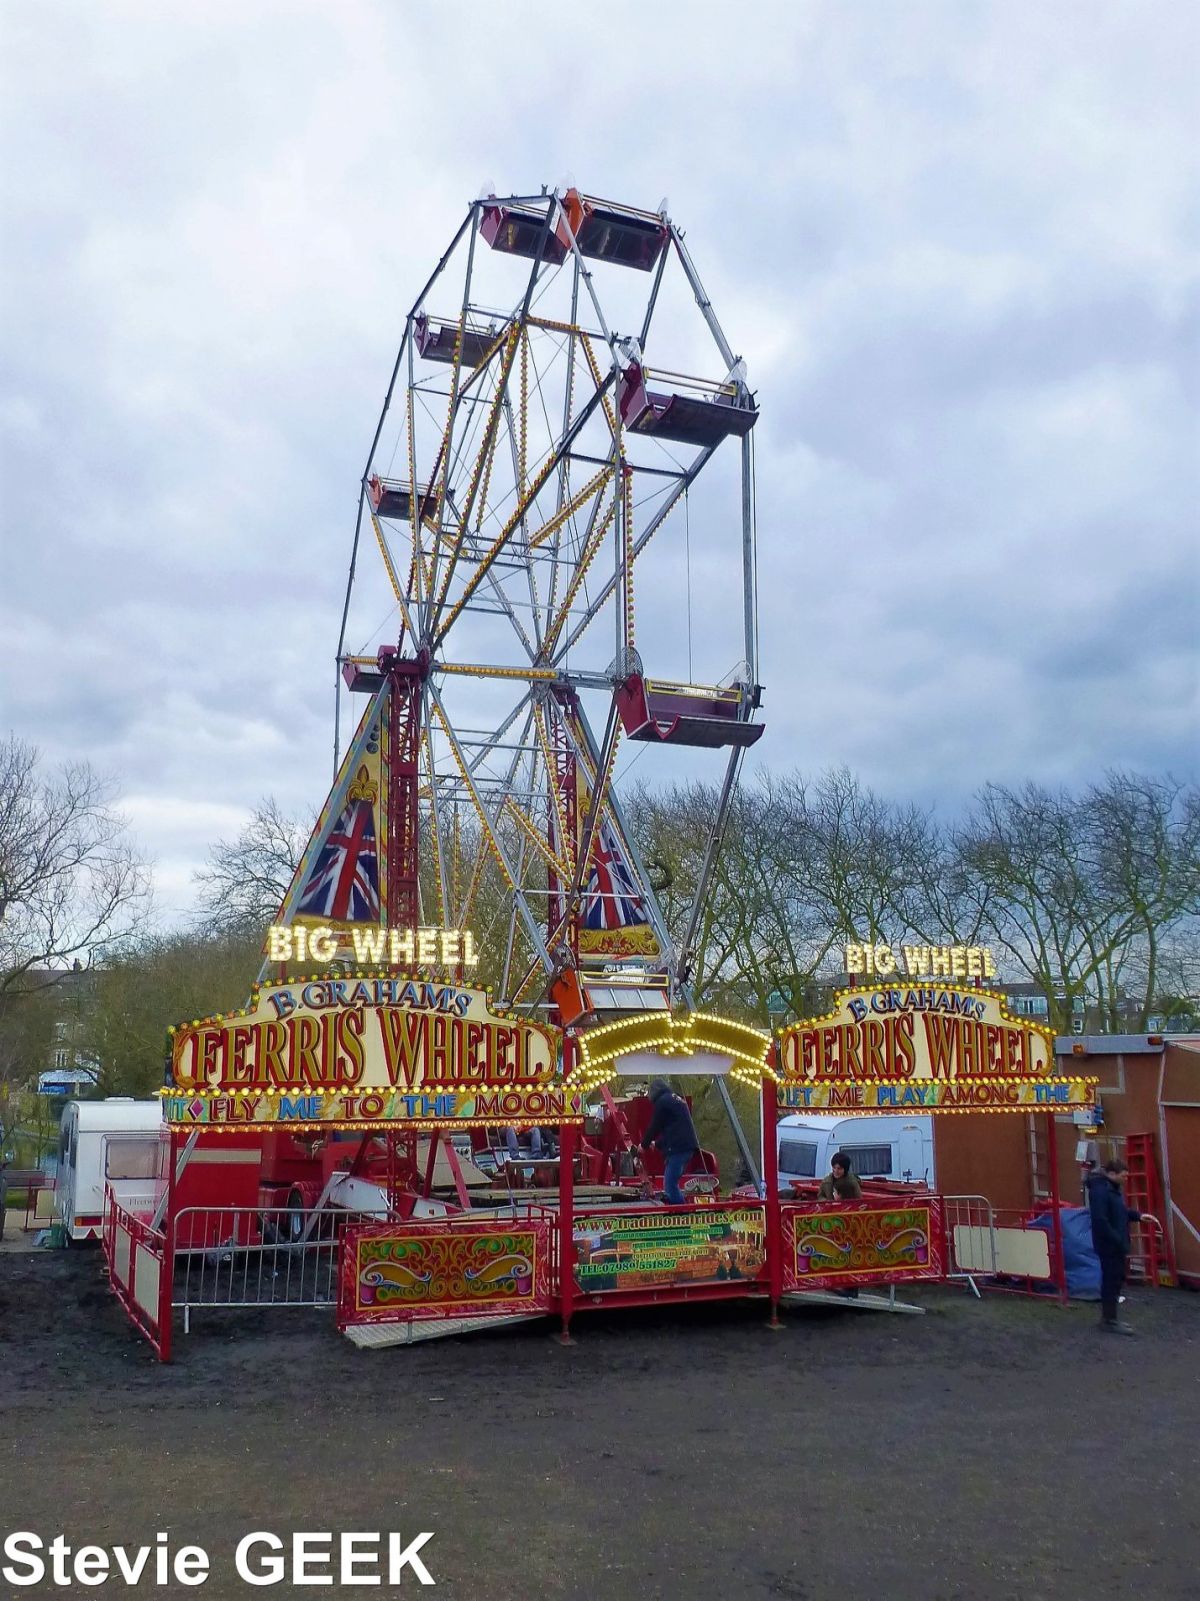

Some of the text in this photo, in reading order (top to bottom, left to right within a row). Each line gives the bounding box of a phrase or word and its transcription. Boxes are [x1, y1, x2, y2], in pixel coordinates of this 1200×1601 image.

[268, 925, 479, 966] BIG WHEEL
[845, 944, 995, 978] BIG WHEEL
[189, 1006, 544, 1089] FERRIS WHEEL
[791, 1012, 1046, 1080] FERRIS WHEEL
[209, 1097, 261, 1121] FLY
[277, 1095, 323, 1119] ME
[340, 1094, 385, 1118] TO
[400, 1094, 458, 1118] THE
[474, 1091, 566, 1116] MOON
[786, 1087, 813, 1106] LET
[829, 1086, 864, 1106] ME
[877, 1085, 929, 1105] PLAY
[940, 1085, 1019, 1105] AMONG
[1033, 1084, 1070, 1103] THE
